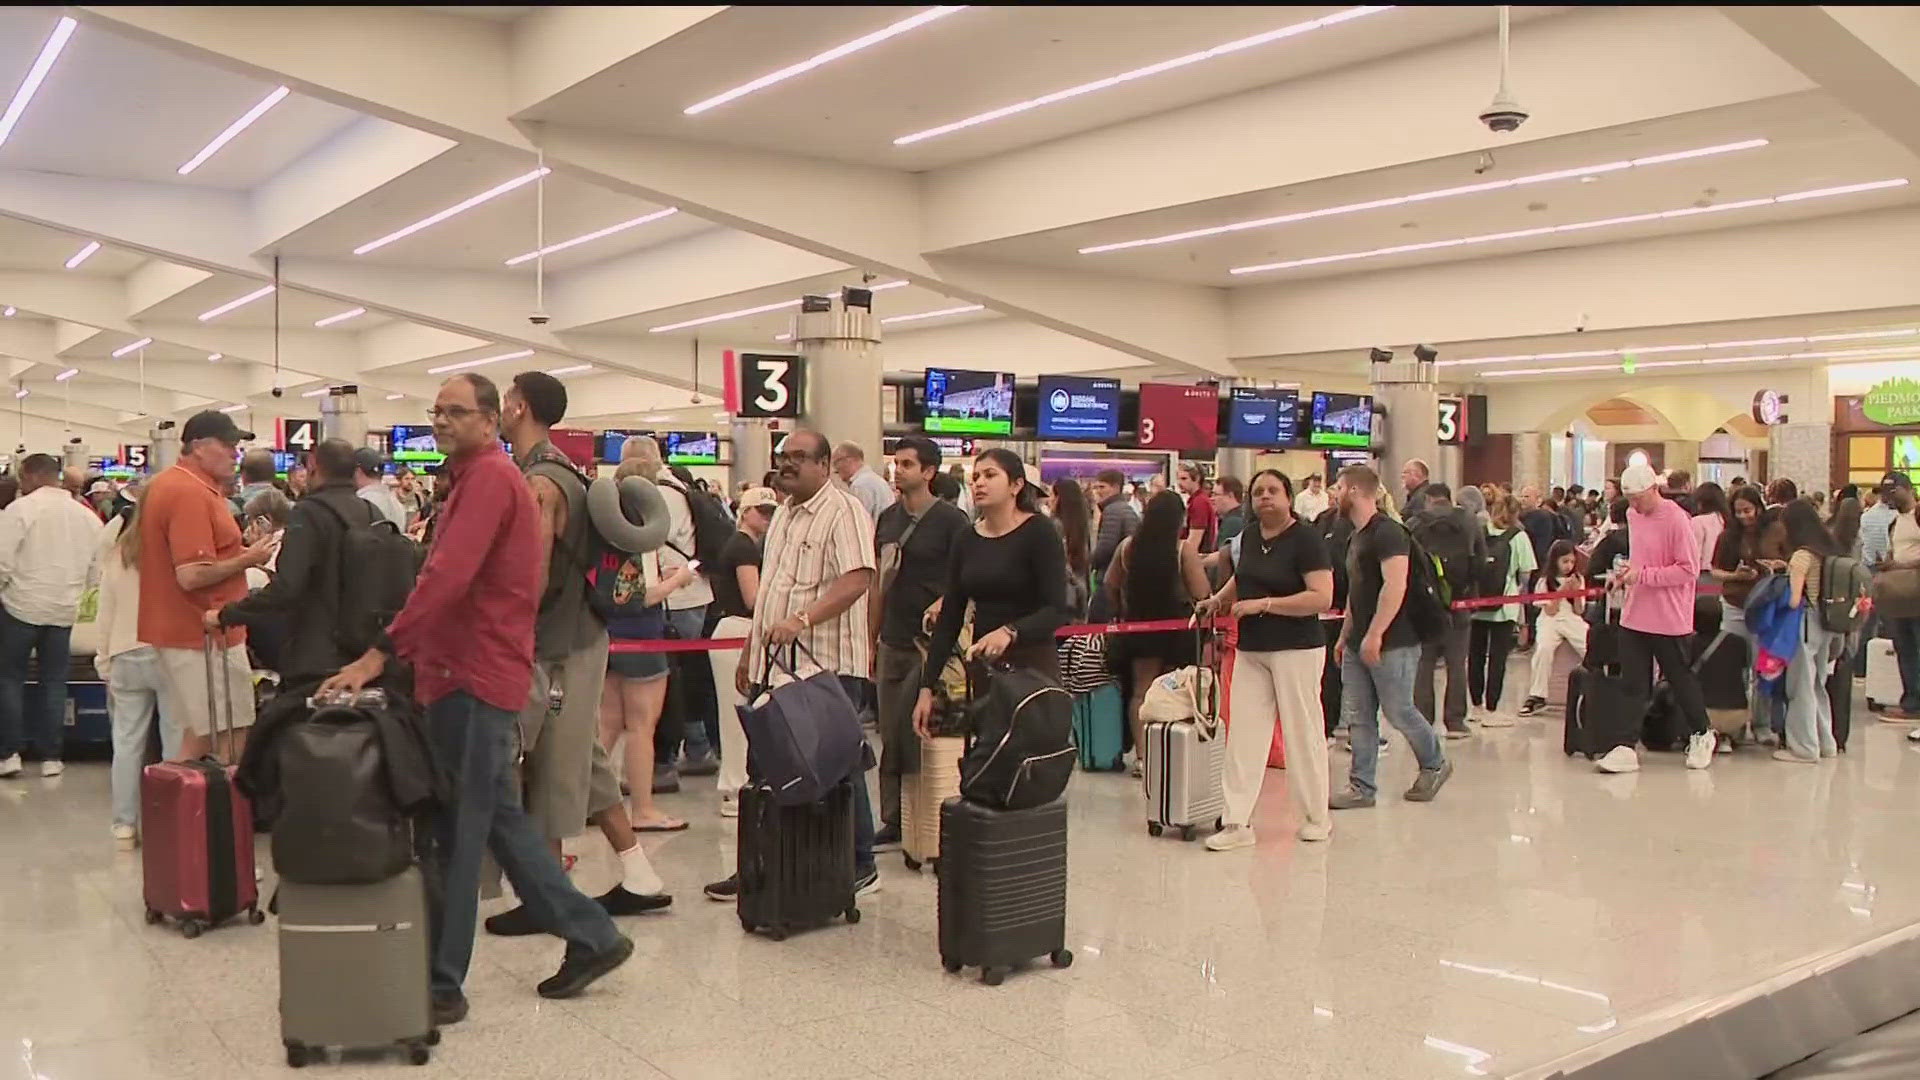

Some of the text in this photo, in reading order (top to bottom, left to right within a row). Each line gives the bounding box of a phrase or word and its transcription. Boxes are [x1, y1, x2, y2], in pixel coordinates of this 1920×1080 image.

[755, 360, 789, 412] 3
[289, 422, 315, 450] 4
[1141, 418, 1154, 444] 3
[1437, 403, 1457, 441] 3
[129, 447, 145, 466] 5
